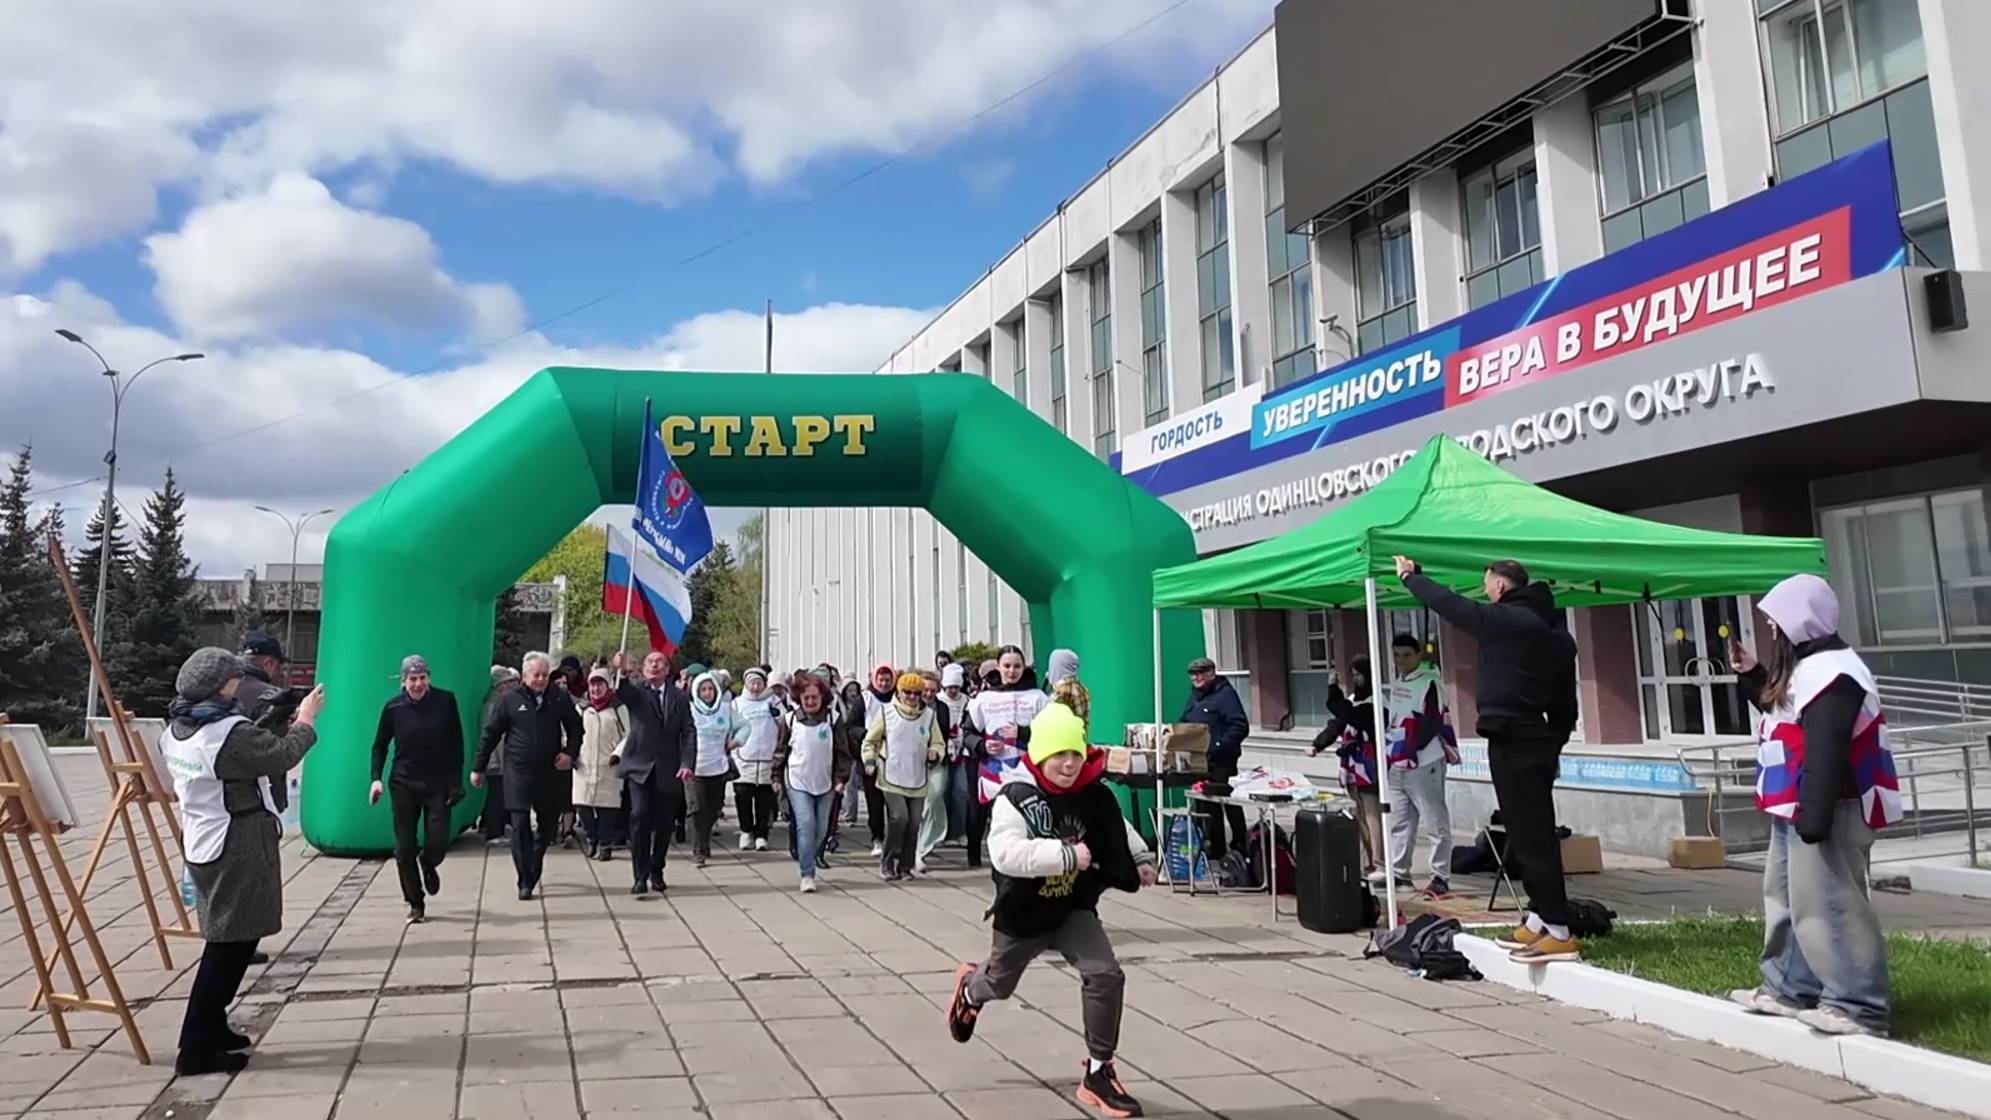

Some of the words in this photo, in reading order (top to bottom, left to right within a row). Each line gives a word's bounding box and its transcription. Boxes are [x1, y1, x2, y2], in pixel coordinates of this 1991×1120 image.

[1458, 335, 1546, 395] ВЕРА
[1557, 321, 1582, 363] В
[1594, 232, 1823, 352] БУДУЩЕЕ
[660, 414, 875, 457] СТАРТ
[1151, 410, 1223, 454] ГОРДОСТЬ
[1262, 350, 1441, 438] УВЕРЕННОСТЬ
[1182, 493, 1252, 531] СТРАЦИЯ
[1455, 394, 1616, 461] ОДСКОГО
[1624, 352, 1775, 421] ОКРУГА
